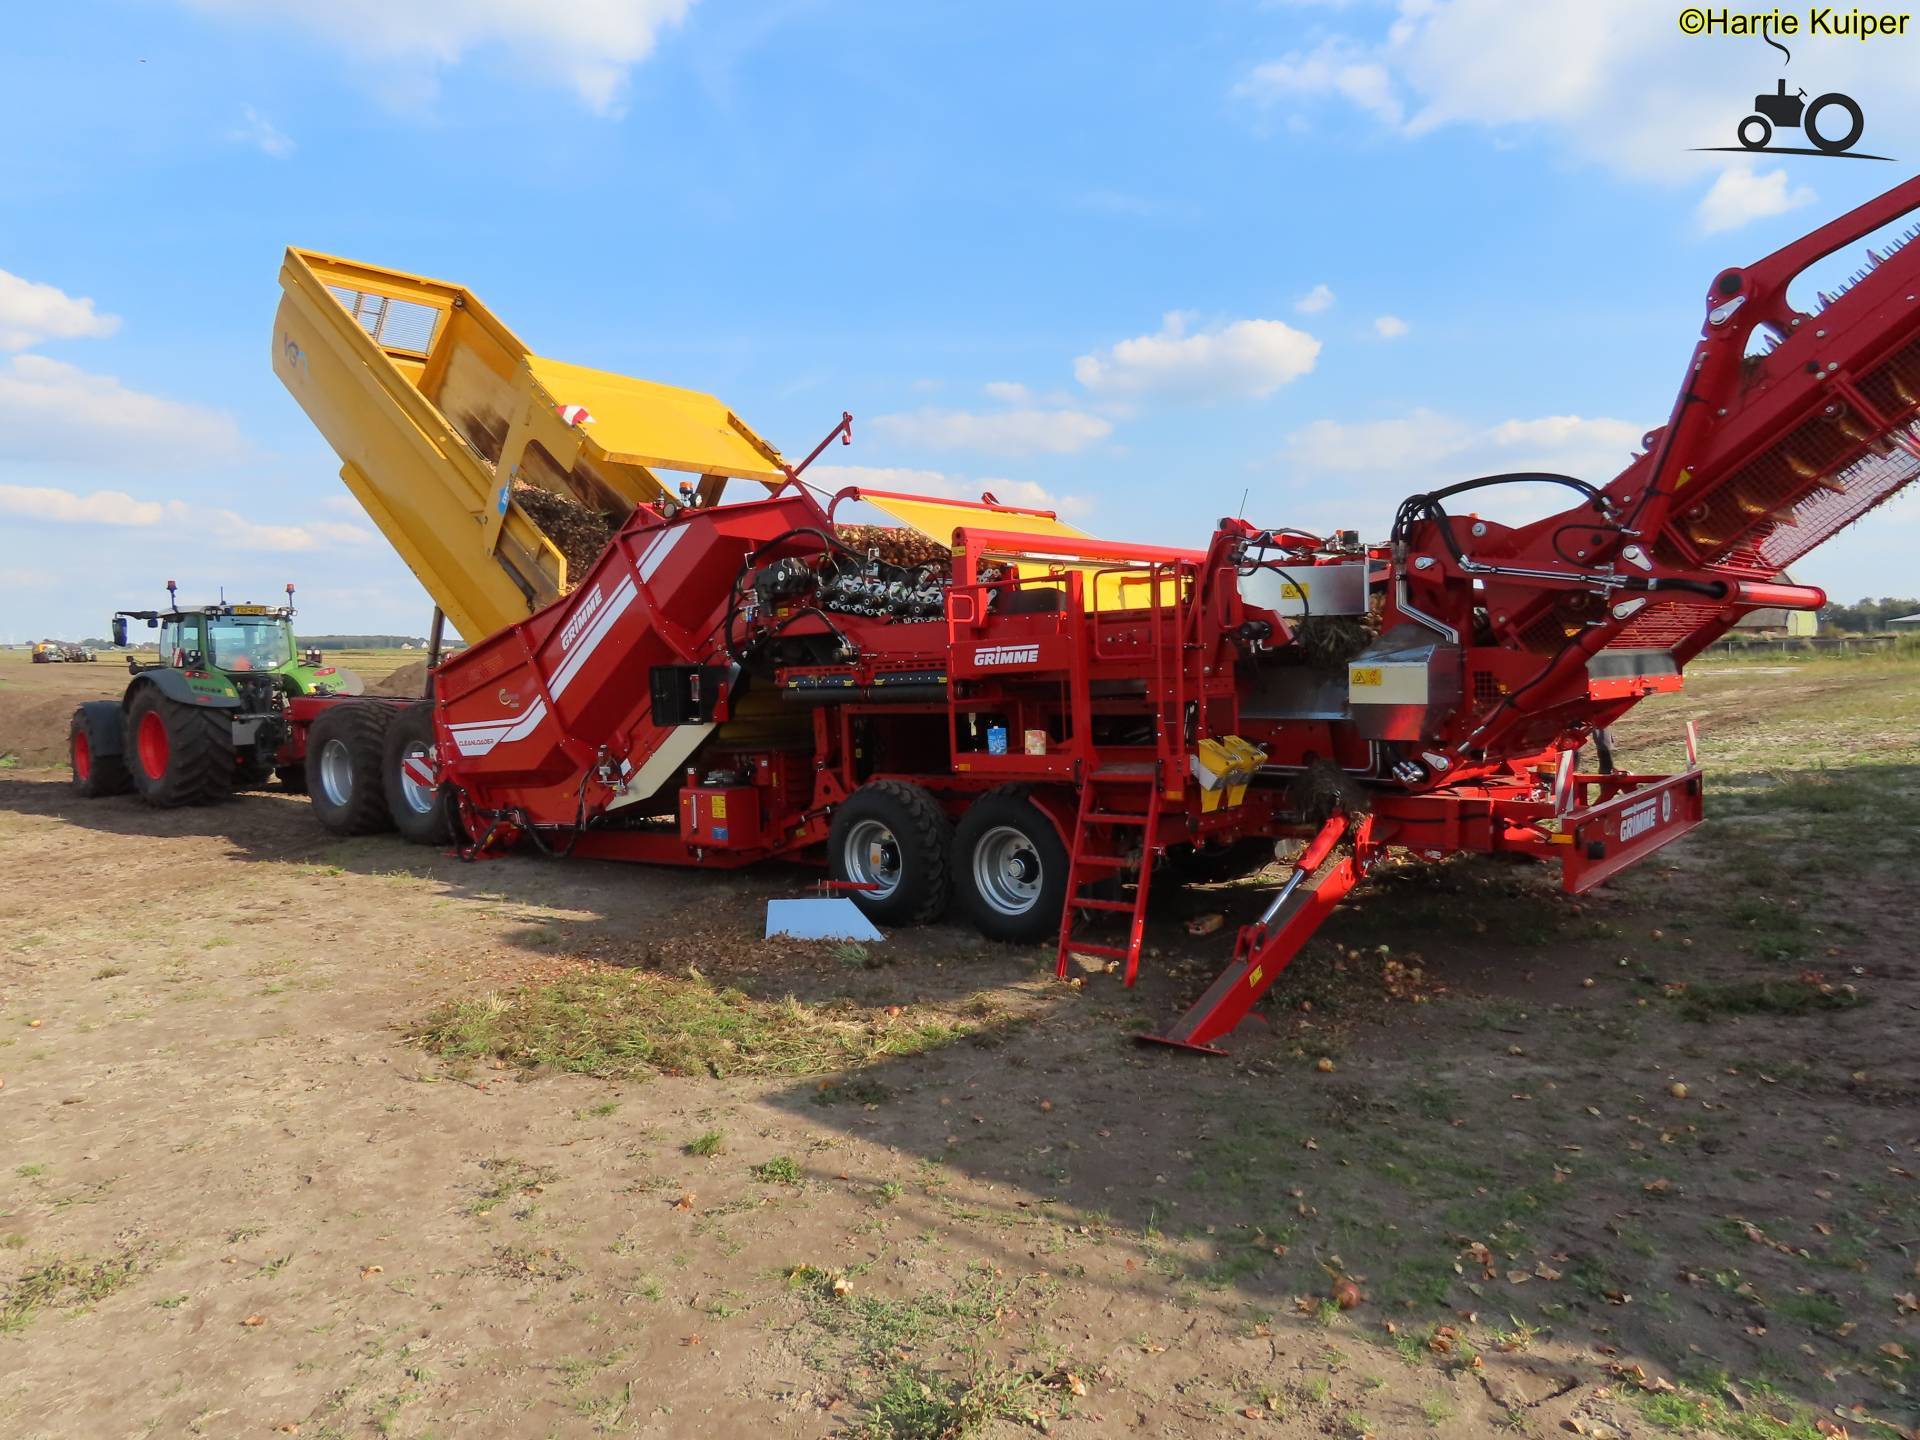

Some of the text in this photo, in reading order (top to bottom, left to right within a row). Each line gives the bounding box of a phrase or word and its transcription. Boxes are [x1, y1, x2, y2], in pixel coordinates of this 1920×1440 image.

[561, 583, 603, 651] GRIMME
[974, 644, 1040, 666] GRIMME
[1620, 798, 1657, 842] GRIMME
